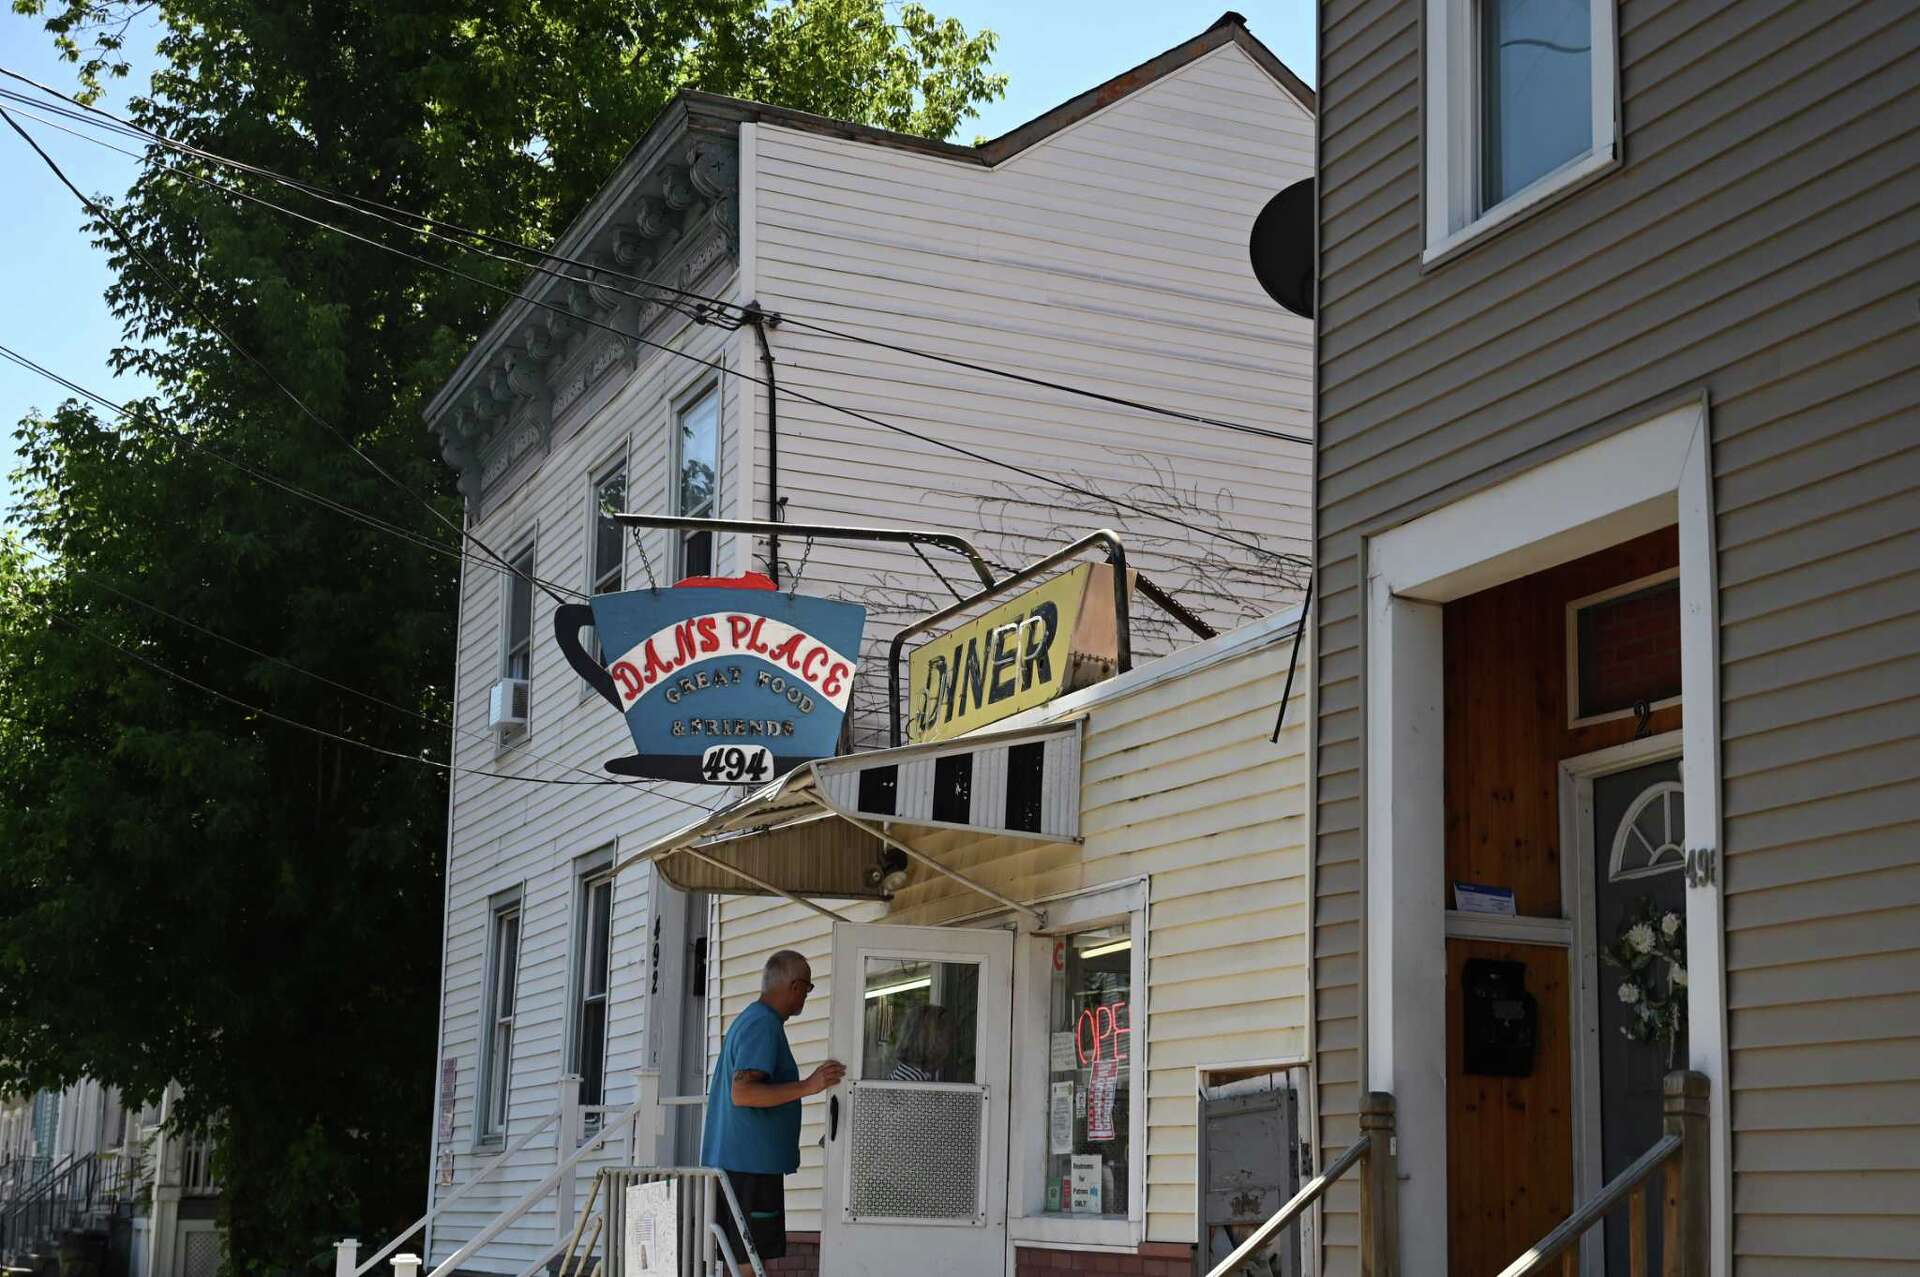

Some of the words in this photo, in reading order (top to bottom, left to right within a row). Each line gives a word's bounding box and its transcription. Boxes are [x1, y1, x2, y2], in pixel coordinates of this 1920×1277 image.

[727, 614, 849, 697] PLACE
[920, 600, 1058, 731] DINER
[665, 666, 742, 704] GREAT
[756, 670, 815, 714] FOOD
[690, 718, 795, 736] FRIENDS
[1632, 702, 1651, 741] 2
[702, 747, 768, 782] 494
[1076, 1001, 1133, 1065] OPE
